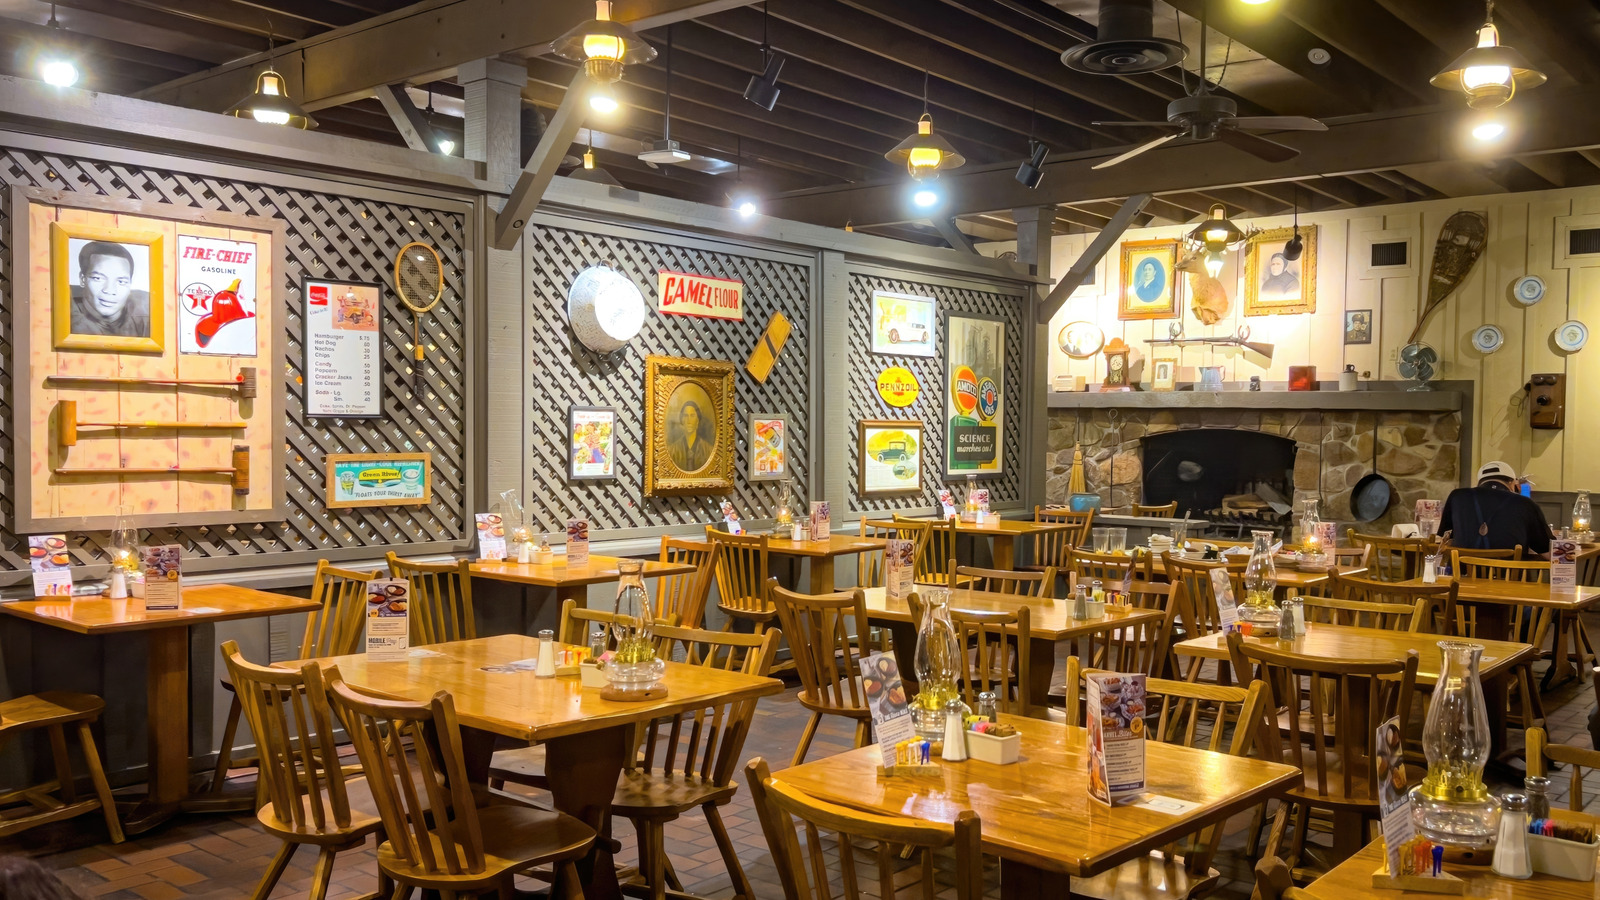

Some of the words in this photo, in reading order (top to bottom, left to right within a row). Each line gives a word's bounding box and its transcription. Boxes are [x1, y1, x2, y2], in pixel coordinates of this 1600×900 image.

[183, 246, 252, 264] FIRE-CHIEF
[201, 266, 237, 275] GASOLINE
[187, 288, 213, 296] TEXACO
[663, 277, 713, 309] CAMEL
[714, 287, 739, 310] FLOUR
[880, 382, 917, 392] PENNZOIL
[958, 381, 977, 396] AMOCO
[959, 434, 990, 443] SCIENCE
[956, 443, 982, 453] marches
